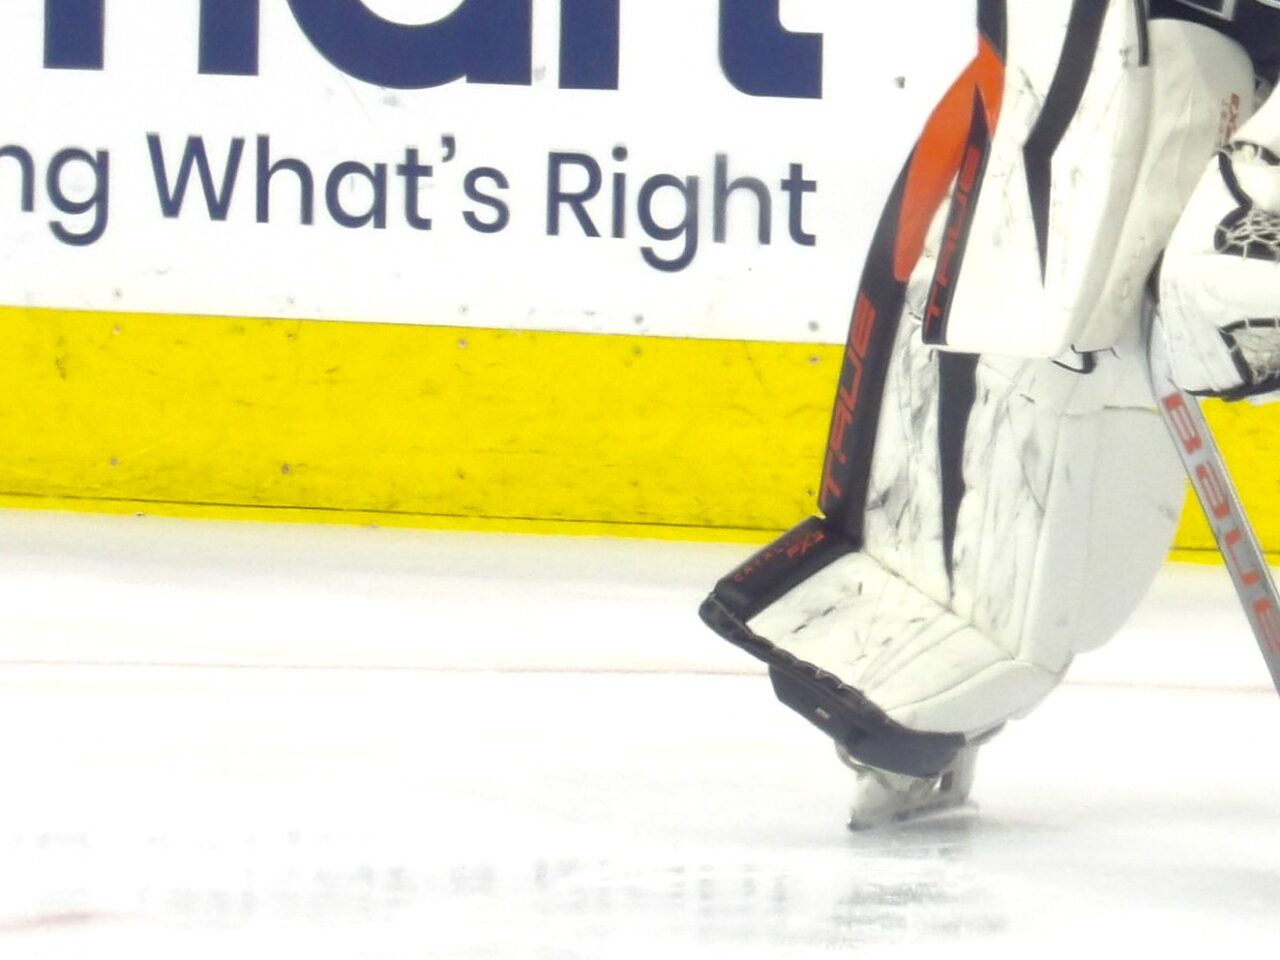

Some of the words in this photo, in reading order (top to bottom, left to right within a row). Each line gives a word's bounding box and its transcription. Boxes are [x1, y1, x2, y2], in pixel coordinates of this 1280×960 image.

[146, 131, 510, 234] What’s
[546, 145, 817, 272] Right
[926, 144, 982, 325] TRUE
[819, 292, 878, 505] TRUE
